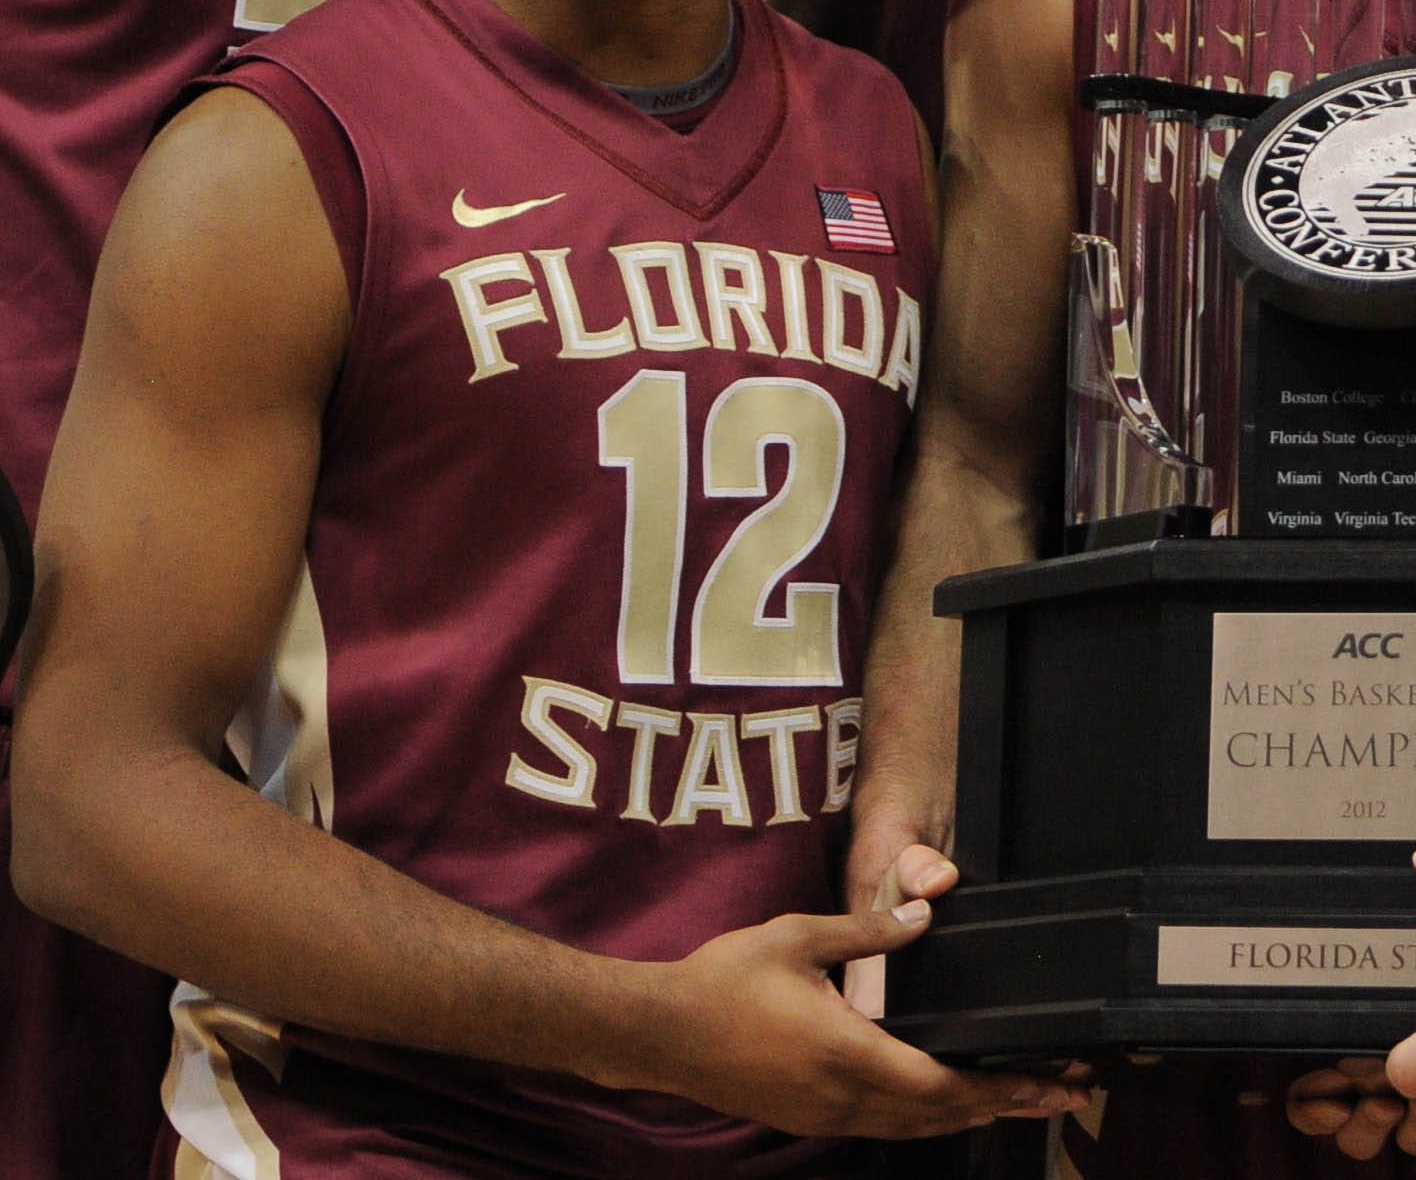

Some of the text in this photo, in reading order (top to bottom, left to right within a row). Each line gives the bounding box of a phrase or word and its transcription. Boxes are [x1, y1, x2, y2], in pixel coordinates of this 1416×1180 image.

[652, 86, 697, 108] NIKE
[440, 241, 921, 410] FLORIDA
[1280, 390, 1328, 404] Boston
[1332, 390, 1384, 408] College
[1269, 430, 1319, 445] Florida
[1322, 431, 1356, 445] State
[1277, 471, 1322, 485] Miami
[1338, 471, 1377, 485] North
[598, 369, 847, 687] 12
[1267, 512, 1322, 528] Virginia
[1334, 512, 1389, 528] Virginia
[1333, 633, 1403, 659] ACC
[1340, 801, 1387, 819] 2012
[1229, 942, 1379, 970] FLORIDA
